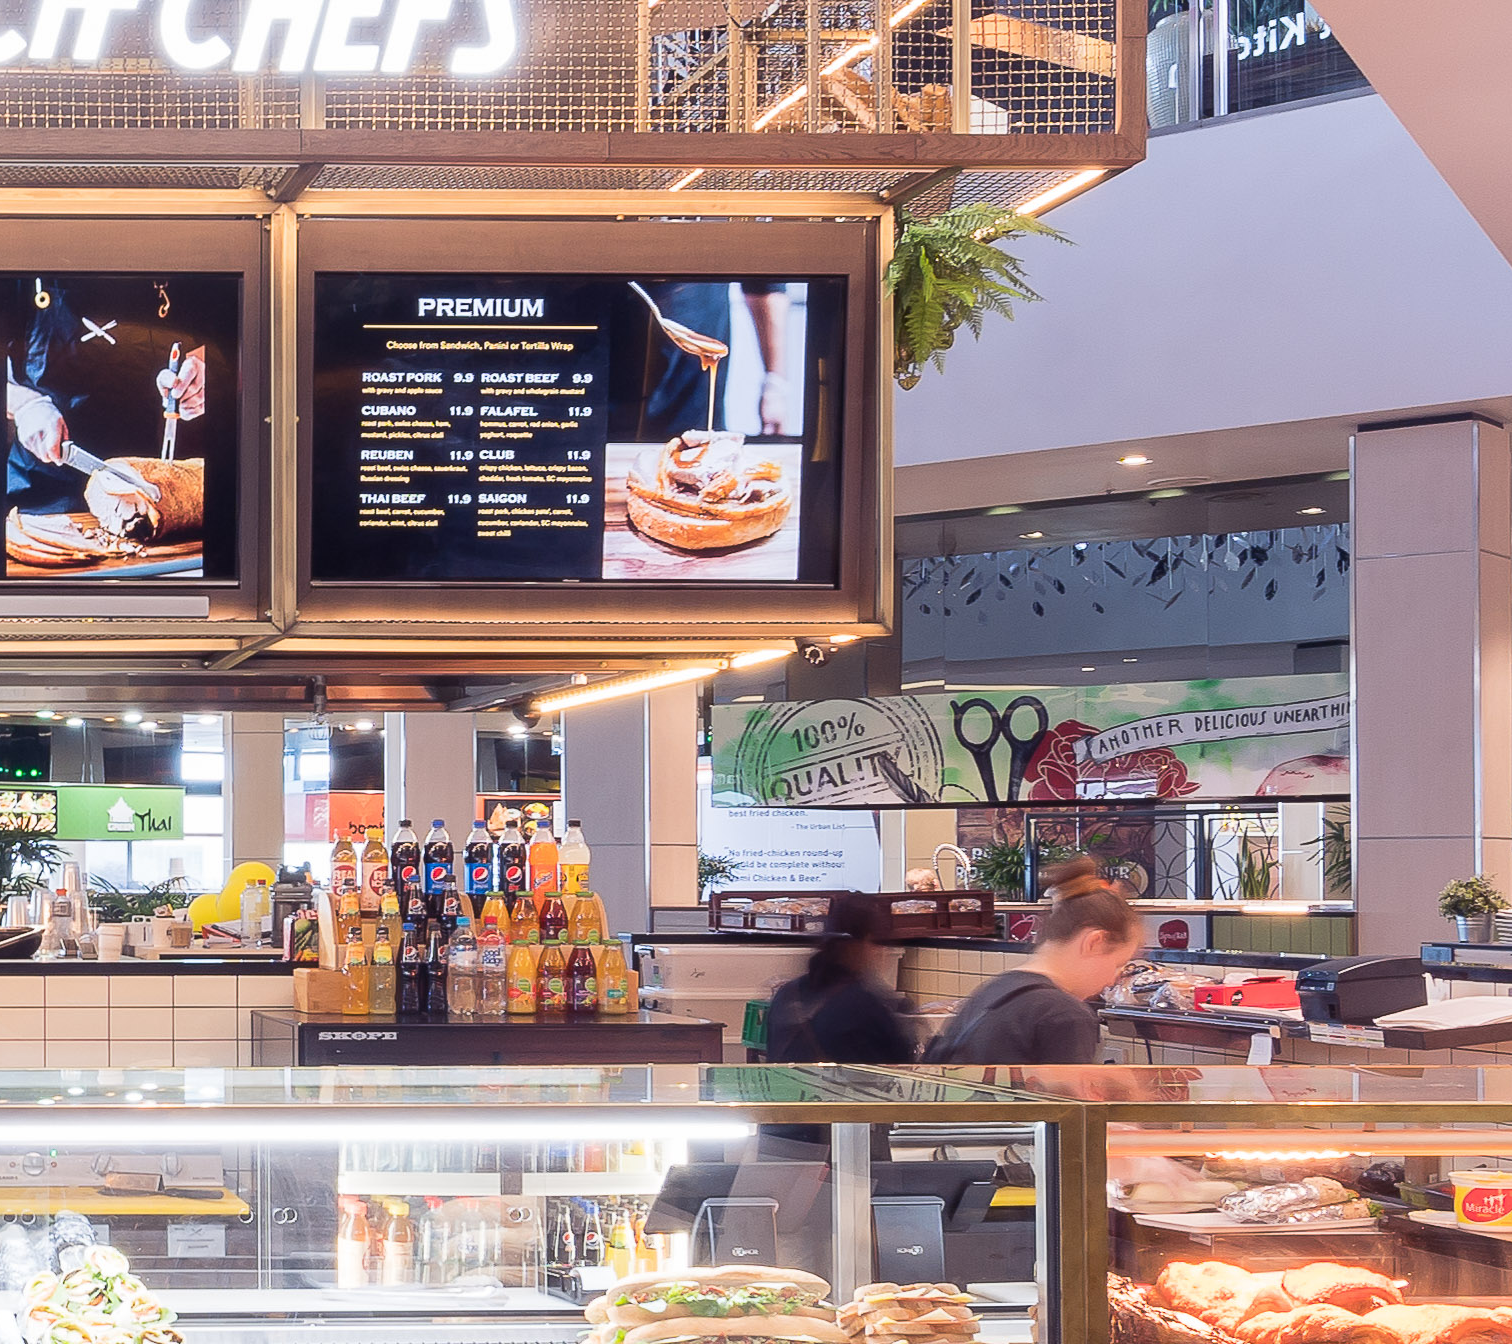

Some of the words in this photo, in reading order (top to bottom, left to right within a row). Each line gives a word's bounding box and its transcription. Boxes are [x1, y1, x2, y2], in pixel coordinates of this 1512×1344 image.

[418, 297, 545, 318] PREMIUM
[386, 341, 417, 350] Choose
[419, 341, 438, 350] from
[440, 341, 482, 351] Sandwich,
[484, 342, 508, 350] Panini
[521, 342, 549, 350] Tortilla
[551, 342, 574, 352] Wrap
[362, 373, 405, 383] ROAST
[406, 373, 442, 383] PORK
[453, 373, 474, 383] 9.9
[481, 373, 524, 383] ROAST
[525, 373, 559, 383] BEEF
[572, 374, 593, 383] 9.9
[361, 406, 416, 416] CUBANO
[450, 406, 473, 416] 11.9
[480, 407, 538, 416] FALAFEL
[568, 407, 592, 416] 11.9
[361, 450, 413, 460] REUBEN
[450, 451, 474, 460] 11.9
[479, 451, 515, 460] CLUB
[567, 451, 591, 460] 11.9
[360, 494, 390, 503] THAI
[392, 494, 426, 503] BEEF
[448, 494, 471, 503] 11.9
[478, 494, 527, 504] SAIGON
[566, 495, 589, 504] 11.9
[791, 711, 865, 752] 100%
[1099, 719, 1182, 754] ANOTHER
[1195, 711, 1267, 732] DELICIOUS
[1274, 701, 1349, 725] UNEARTHI
[803, 850, 843, 858] round-up
[770, 861, 809, 869] complete
[318, 1031, 398, 1041] SKOPE
